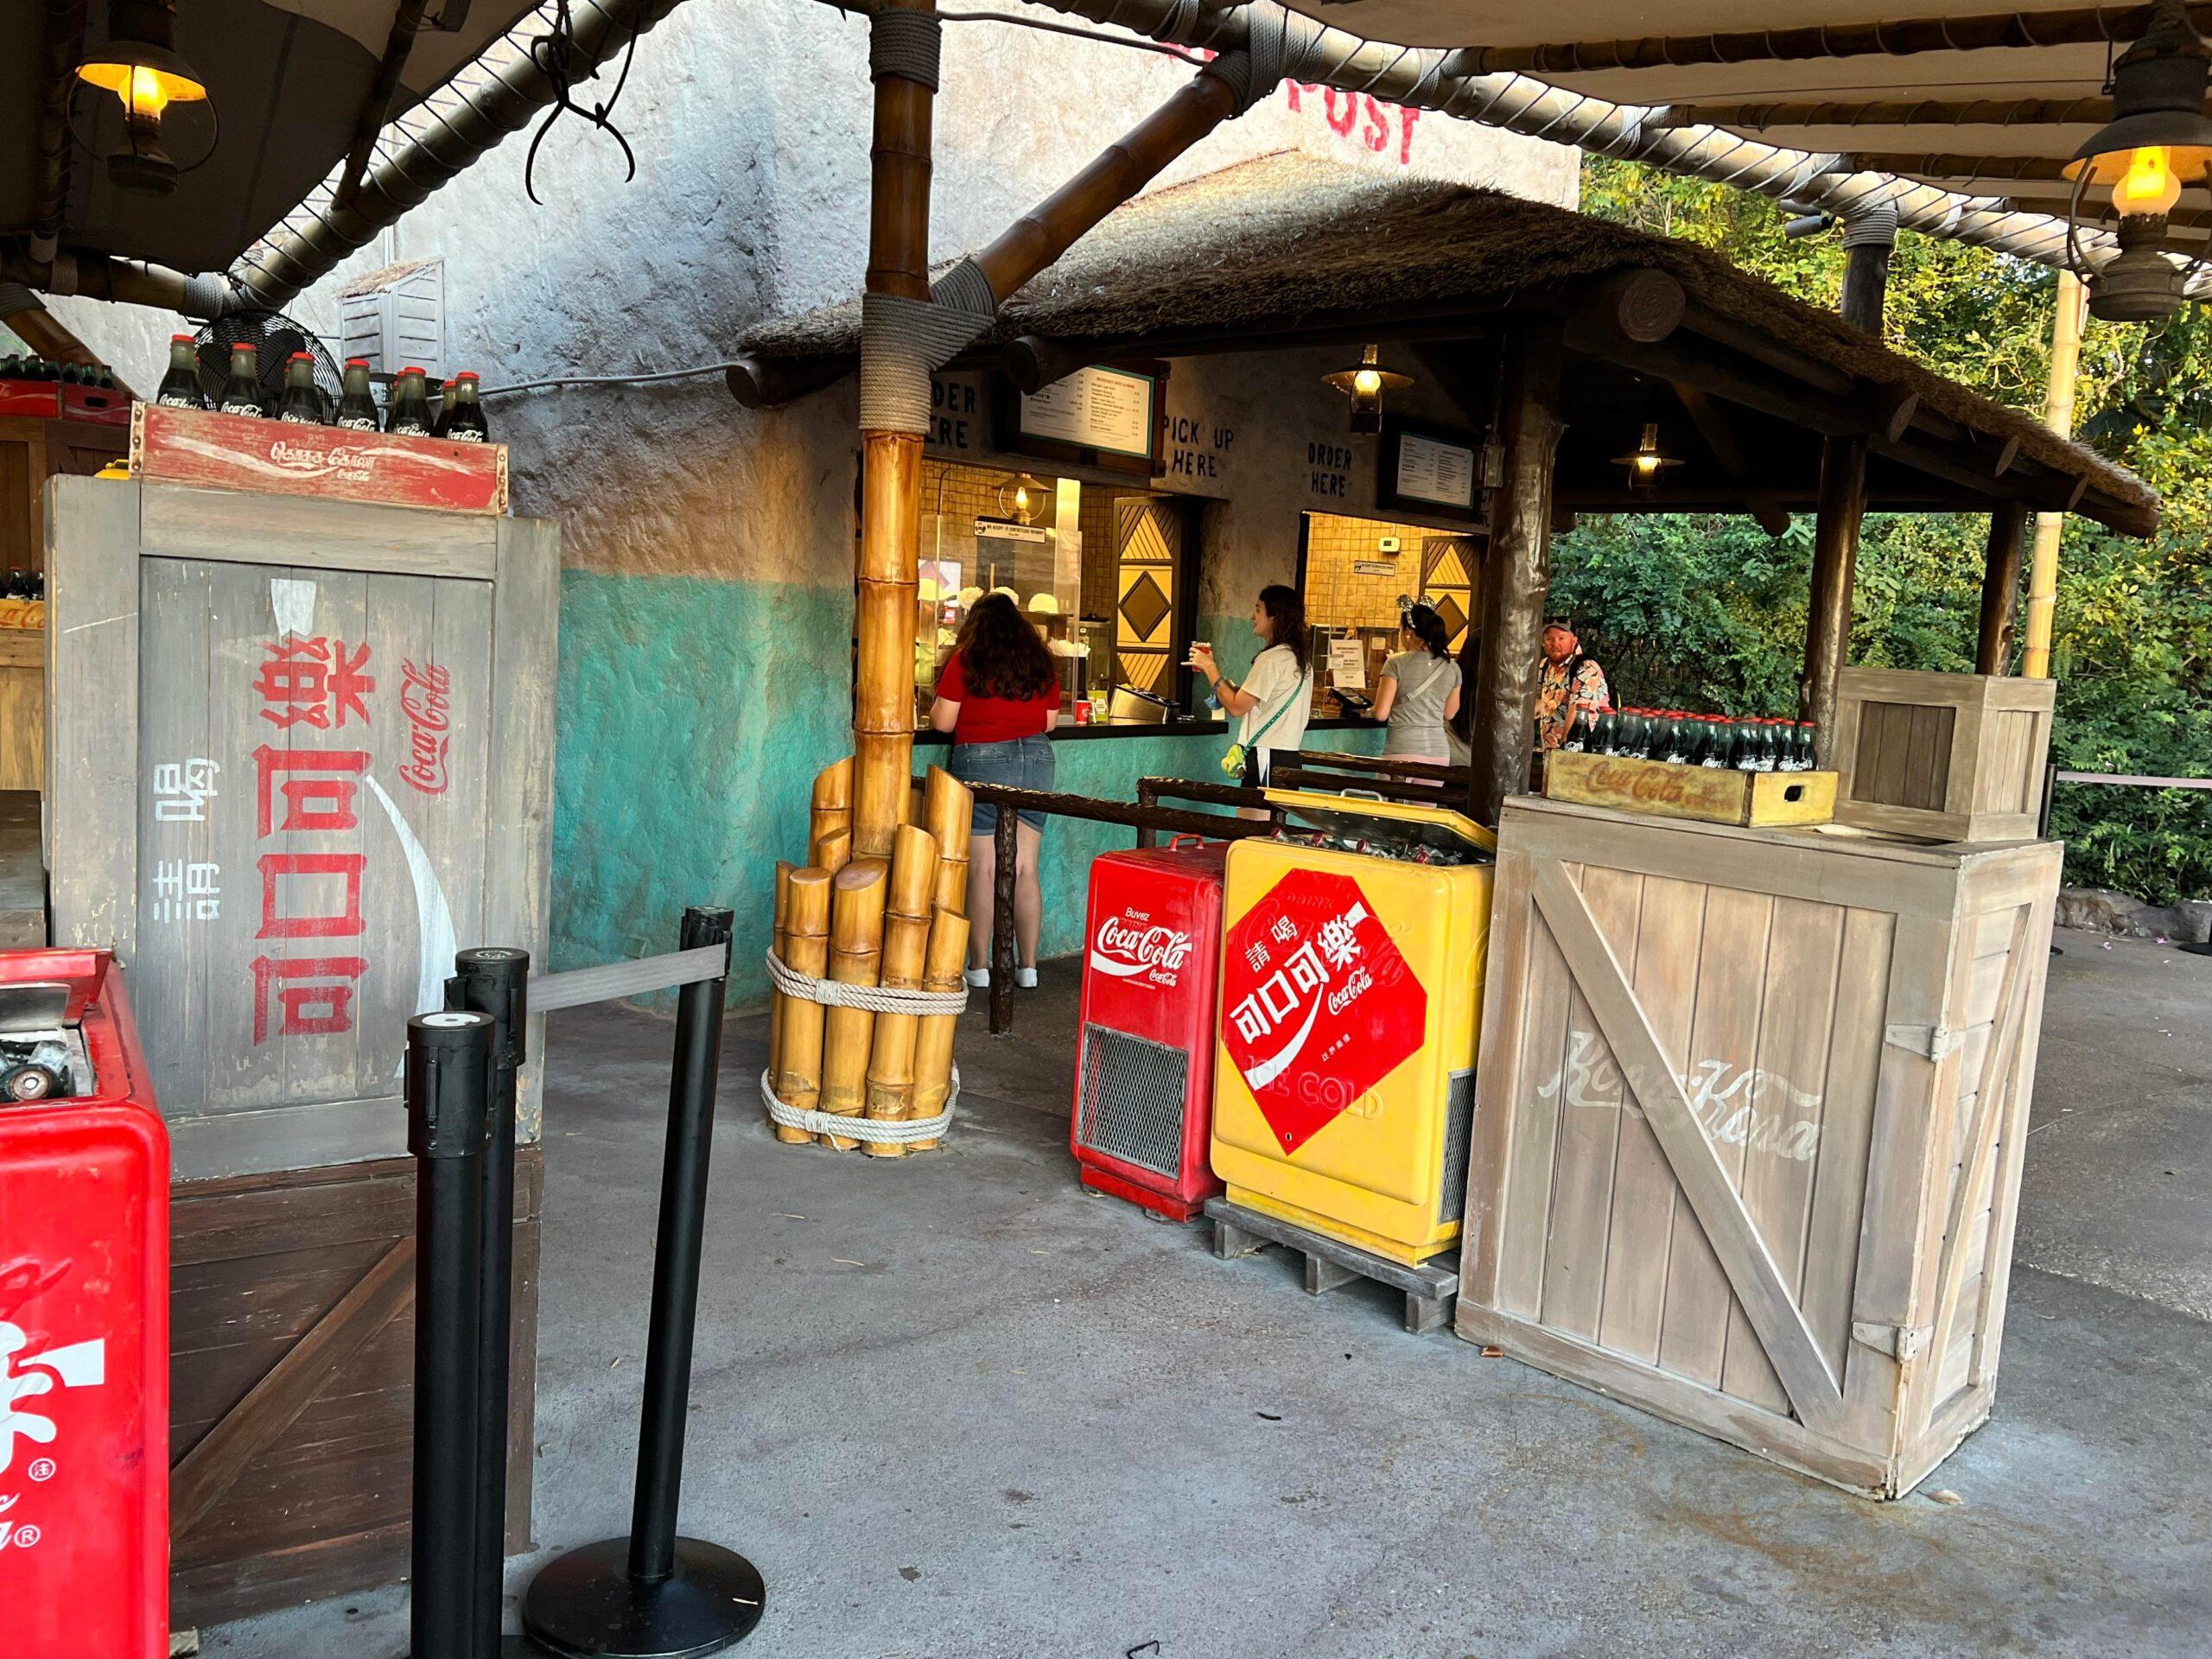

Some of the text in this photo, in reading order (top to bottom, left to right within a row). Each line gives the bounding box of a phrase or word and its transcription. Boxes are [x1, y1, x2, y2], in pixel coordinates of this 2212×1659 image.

[931, 380, 976, 414] DER
[1163, 416, 1234, 450] PICK UP
[1173, 450, 1217, 478] HERE
[1308, 442, 1352, 471] ORDER
[1312, 471, 1346, 498] HERE
[1125, 906, 1150, 922] Buvez
[1244, 914, 1298, 974] 請喝
[1229, 913, 1362, 1045] 可口可樂
